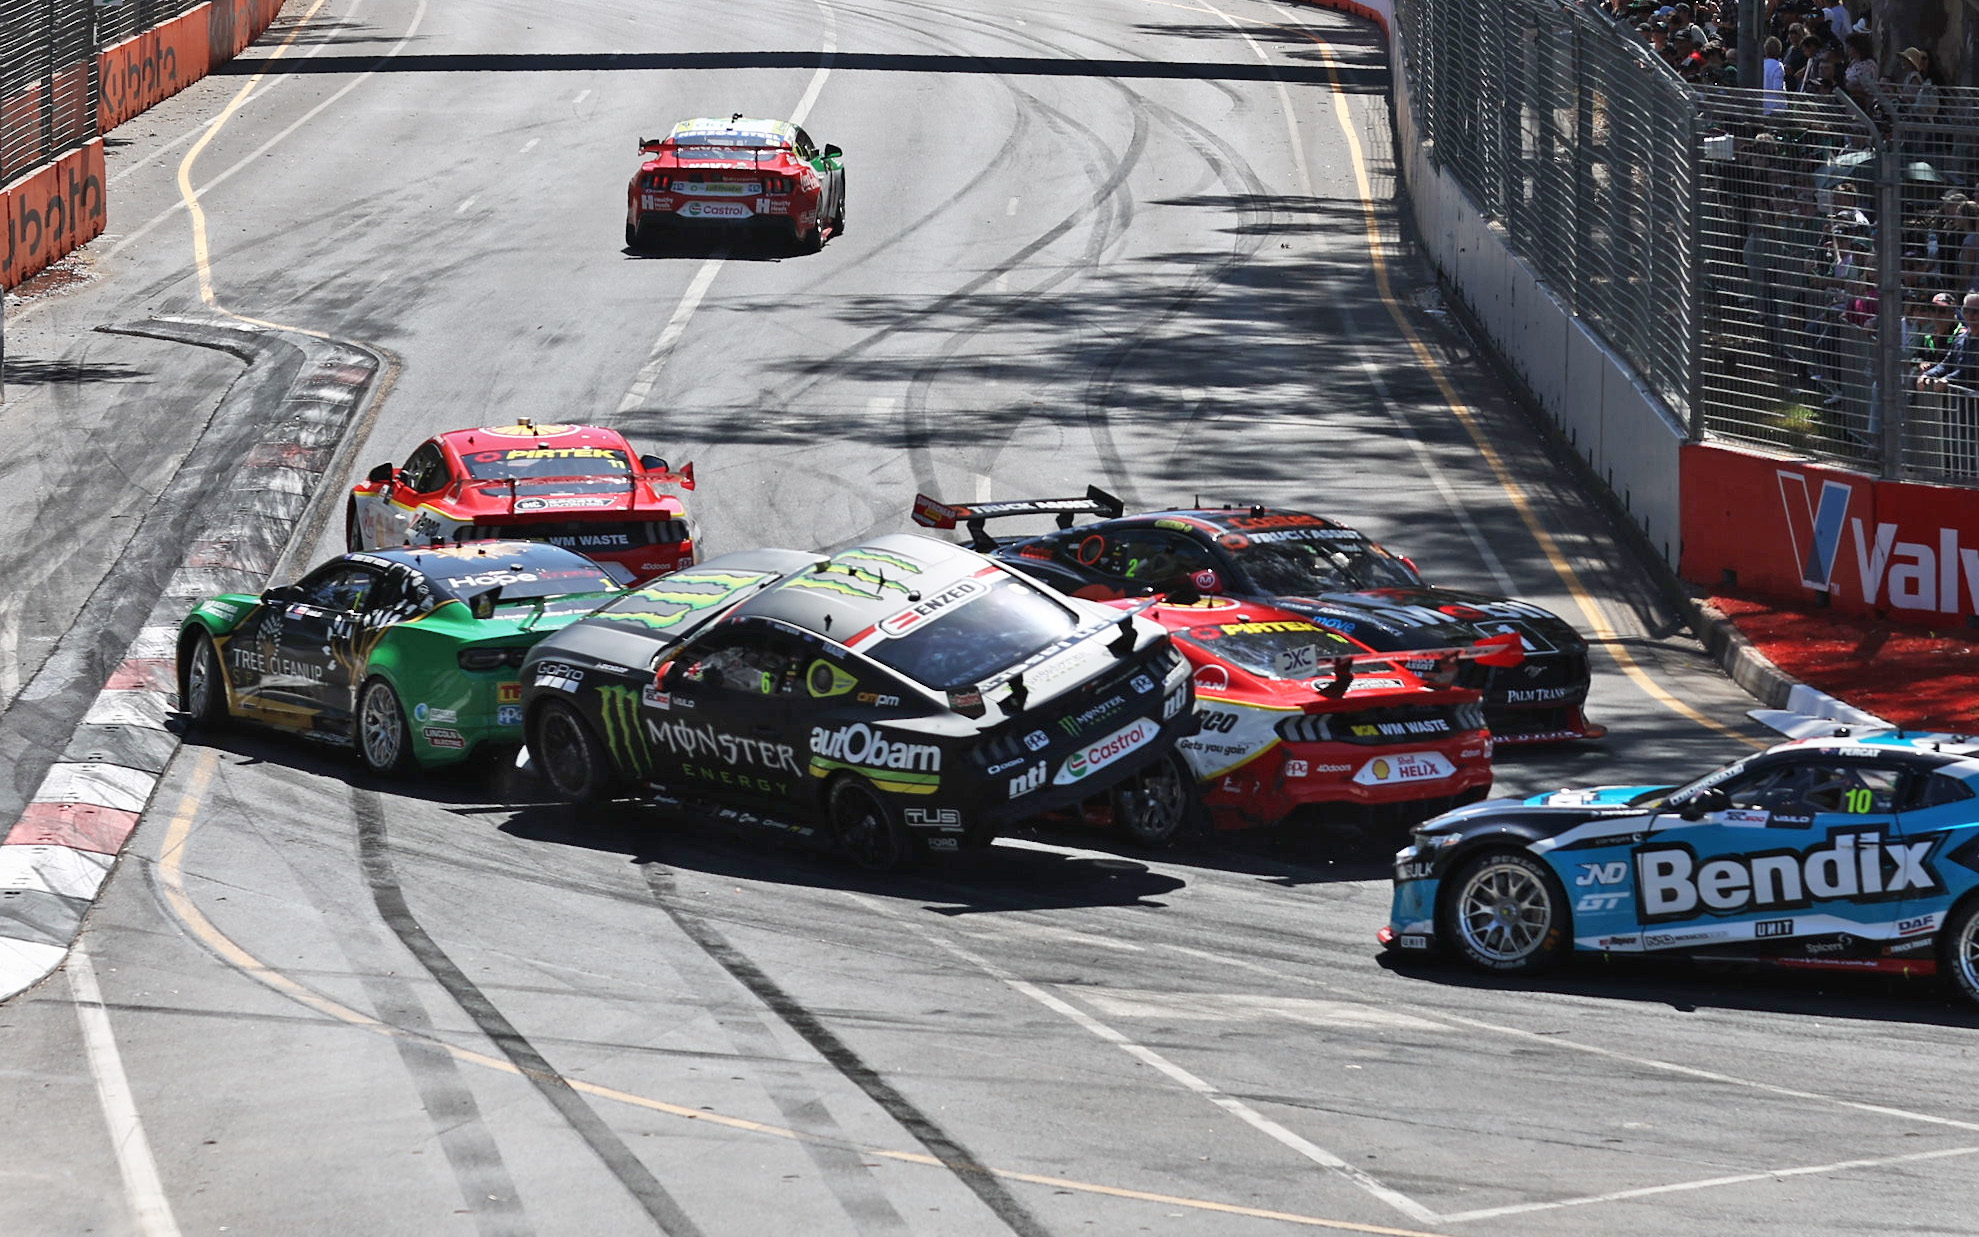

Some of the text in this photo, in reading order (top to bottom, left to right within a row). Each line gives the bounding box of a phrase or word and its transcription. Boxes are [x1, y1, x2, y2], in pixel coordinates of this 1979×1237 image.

[100, 37, 176, 114] Kubota
[703, 206, 743, 215] Castrol
[0, 168, 101, 272] ubota
[506, 449, 615, 460] PIRTEK
[608, 460, 625, 469] 11
[967, 499, 1098, 514] TRUCK ASSIST
[550, 534, 629, 546] WM WASTE
[1247, 528, 1363, 543] TRUCK ASSIST
[1125, 559, 1139, 578] 2
[448, 571, 538, 588] Hope
[915, 584, 976, 616] ENZED
[1220, 621, 1325, 636] PIRTEK
[1312, 615, 1357, 633] move
[233, 649, 265, 674] TREE
[270, 654, 323, 682] CLEANUP
[537, 662, 584, 681] GoPro
[760, 671, 771, 694] 6
[857, 692, 899, 707] ampm
[1163, 682, 1187, 719] nti
[1508, 690, 1534, 703] PALM
[425, 729, 456, 738] LINCOLN
[1377, 723, 1406, 735] WM
[1405, 719, 1451, 733] WASTE
[1027, 732, 1048, 747] PPG
[1088, 725, 1145, 765] Castrol
[1180, 738, 1203, 750] Gets
[1205, 744, 1224, 754] you
[1838, 748, 1881, 757] PERCAT
[1287, 761, 1308, 775] PPG
[1399, 762, 1440, 778] HELIX
[683, 763, 793, 795] ENERGY
[1009, 761, 1047, 796] nti
[1846, 788, 1873, 813] 10
[907, 808, 958, 823] TUS
[1637, 832, 1936, 915] Bendix
[1576, 891, 1631, 911] GT
[1757, 921, 1792, 936] UNIT
[1899, 915, 1934, 930] DAF
